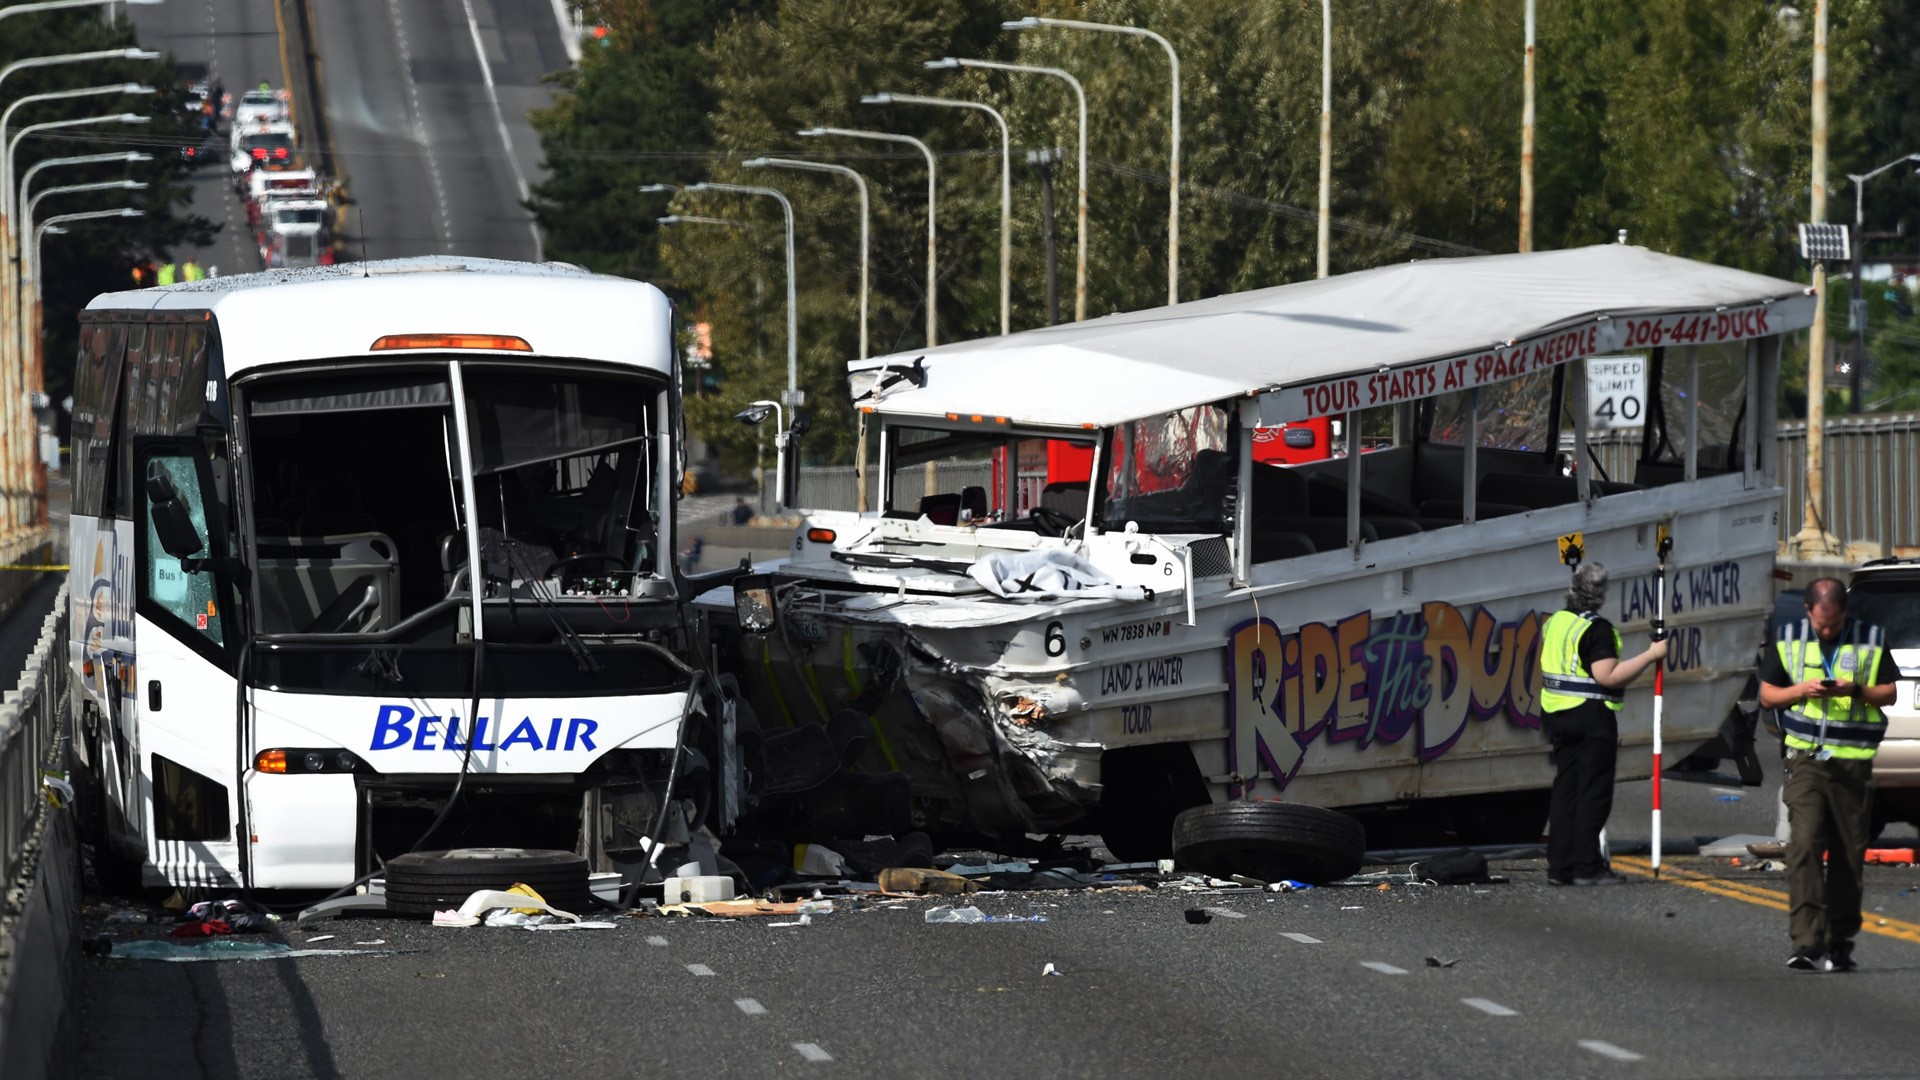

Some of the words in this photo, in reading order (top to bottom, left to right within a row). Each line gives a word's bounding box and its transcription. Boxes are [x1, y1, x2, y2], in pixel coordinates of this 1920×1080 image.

[1303, 379, 1361, 416] TOUR
[1368, 366, 1436, 403] STARTS
[1443, 359, 1467, 389] AT
[1475, 349, 1529, 380] SPACE
[1533, 325, 1597, 366] NEEDLE
[1625, 309, 1769, 347] 206-441-DUCK
[1591, 362, 1641, 376] SPEED
[1596, 379, 1635, 392] LIMIT
[1595, 396, 1641, 421] 40
[1772, 511, 1779, 525] 6
[796, 536, 803, 551] 6
[159, 569, 175, 581] Bus
[1163, 562, 1174, 576] 6
[1621, 573, 1666, 623] LAND
[1671, 570, 1683, 614] &
[1688, 560, 1740, 611] WATER
[1044, 620, 1066, 657] 6
[1102, 629, 1118, 644] WN
[1120, 623, 1143, 641] 7838
[1146, 622, 1161, 637] NP
[1663, 627, 1702, 673] OUR
[1101, 665, 1133, 695] LAND
[1135, 662, 1143, 691] &
[1147, 656, 1184, 688] WATER
[369, 704, 599, 752] BELLAIR
[1121, 704, 1153, 735] TOUR
